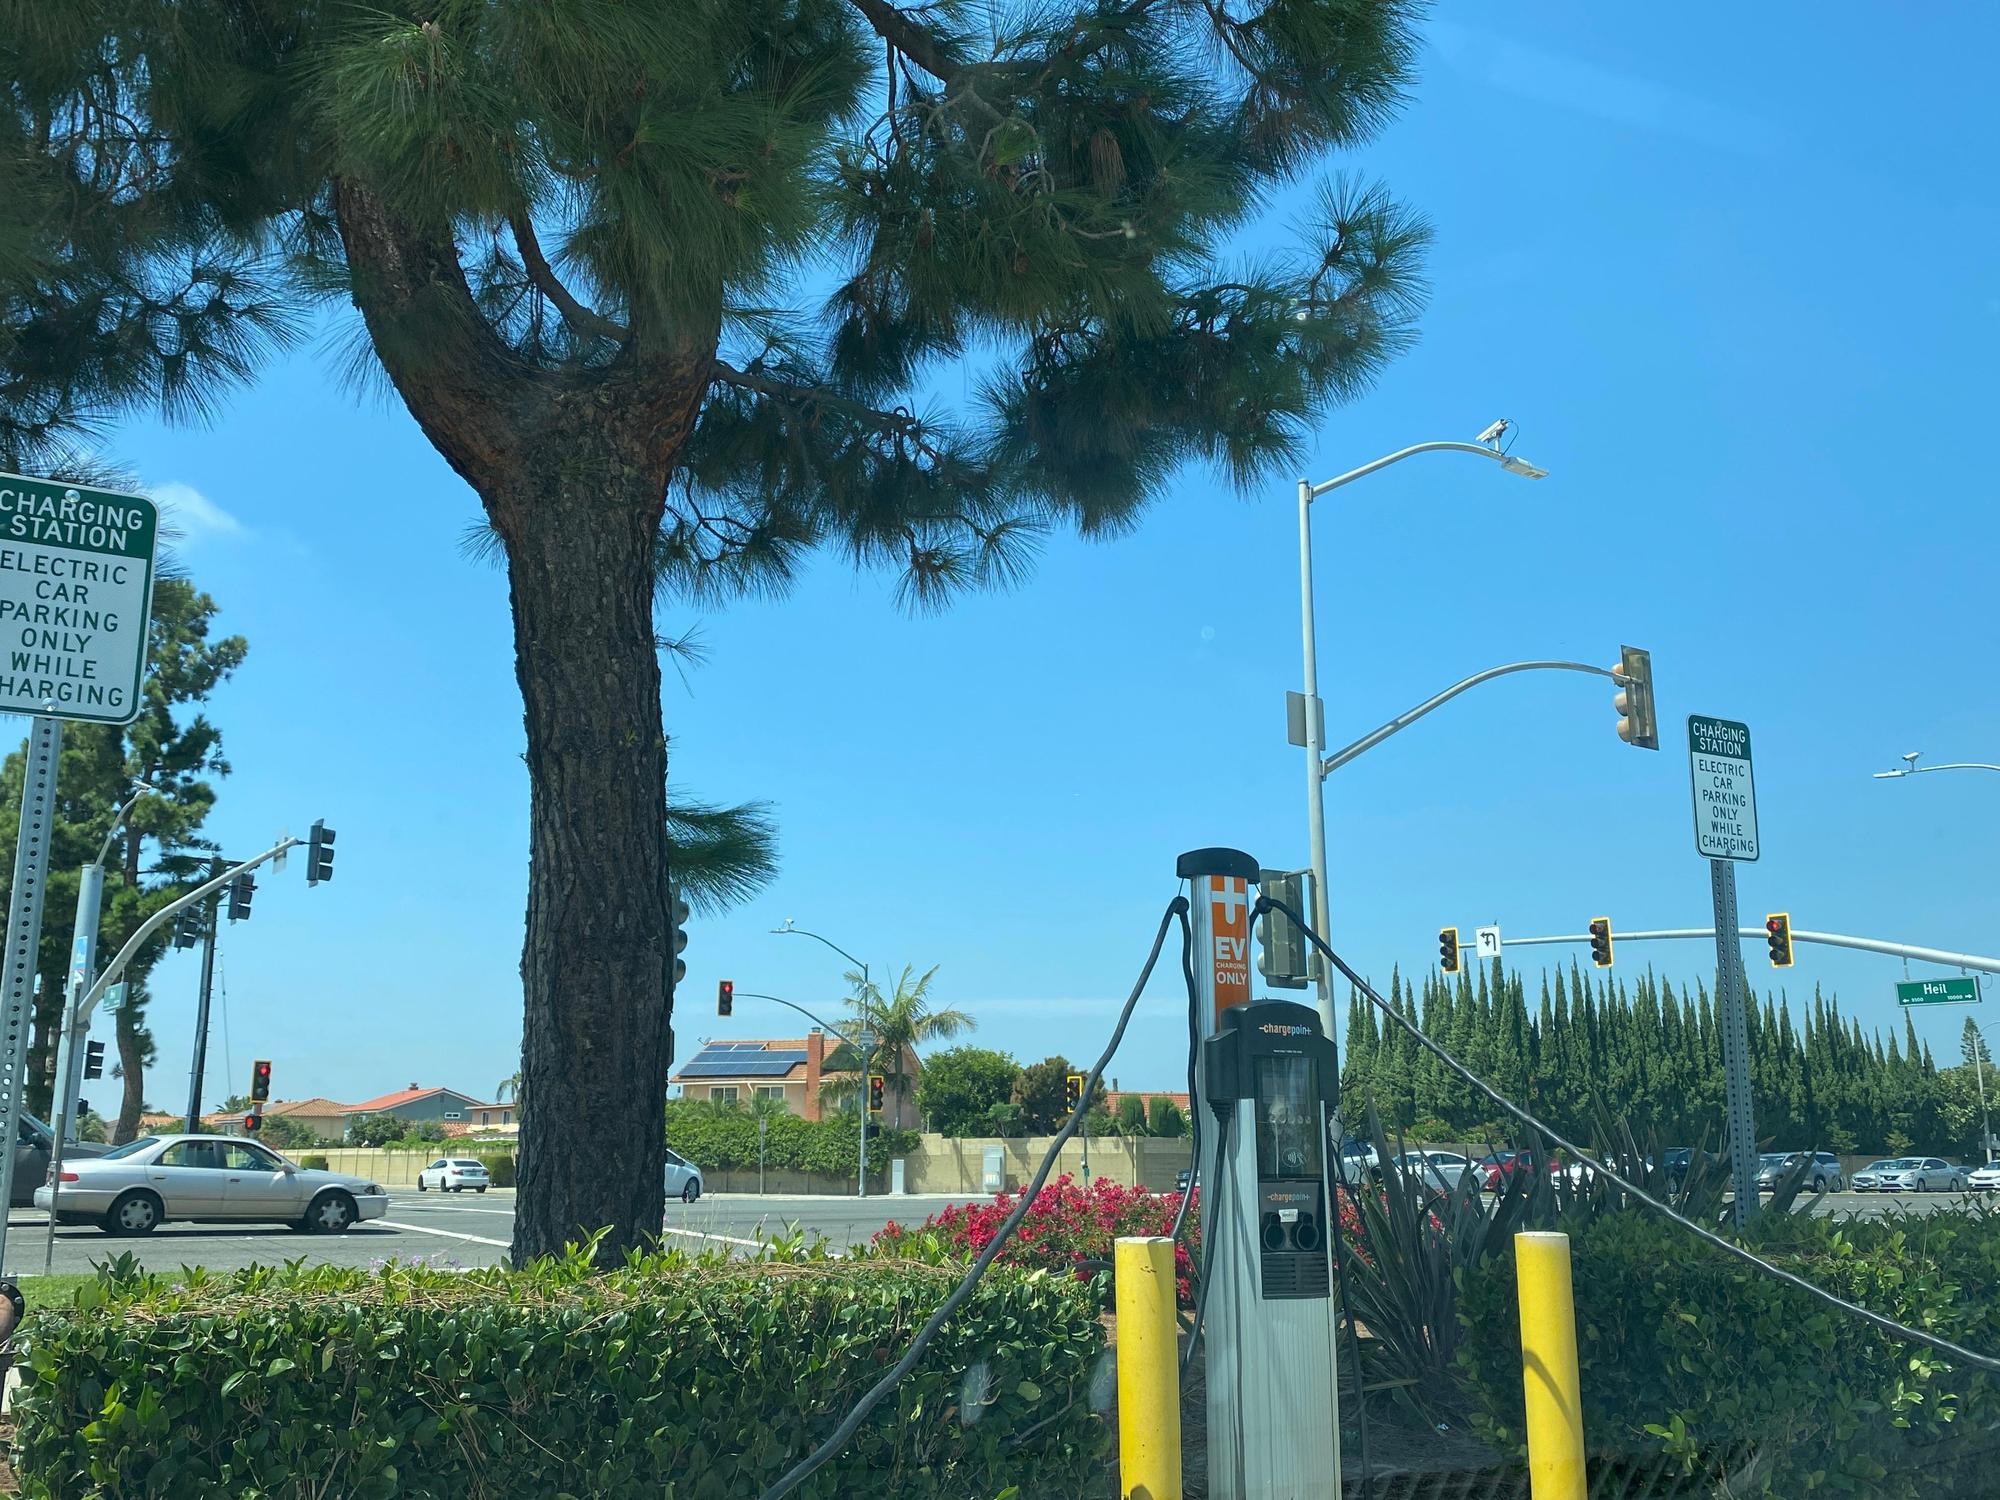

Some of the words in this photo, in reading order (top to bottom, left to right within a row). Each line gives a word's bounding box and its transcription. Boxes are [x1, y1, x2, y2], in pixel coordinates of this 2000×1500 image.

[0, 489, 143, 531] CHARGING
[9, 514, 127, 551] STATION
[0, 549, 128, 585] ELECTRIC
[36, 580, 89, 604] CAR
[0, 599, 118, 632] PARKING
[21, 627, 92, 653] ONLY
[11, 651, 97, 680] WHILE
[0, 675, 123, 707] HARGING
[1693, 722, 1746, 743] CHARGING
[1699, 737, 1742, 756] STATION
[1699, 759, 1745, 777] ELECTRIC
[1713, 776, 1733, 790] CAR
[1702, 789, 1746, 807] PARKING
[1712, 805, 1738, 821] ONLY
[1711, 820, 1743, 837] WHILE
[1702, 834, 1754, 853] CHARGING
[1215, 936, 1246, 961] EV
[1216, 962, 1247, 970] CHARGING
[1216, 971, 1247, 985] ONLY
[1923, 983, 1948, 995] Heil
